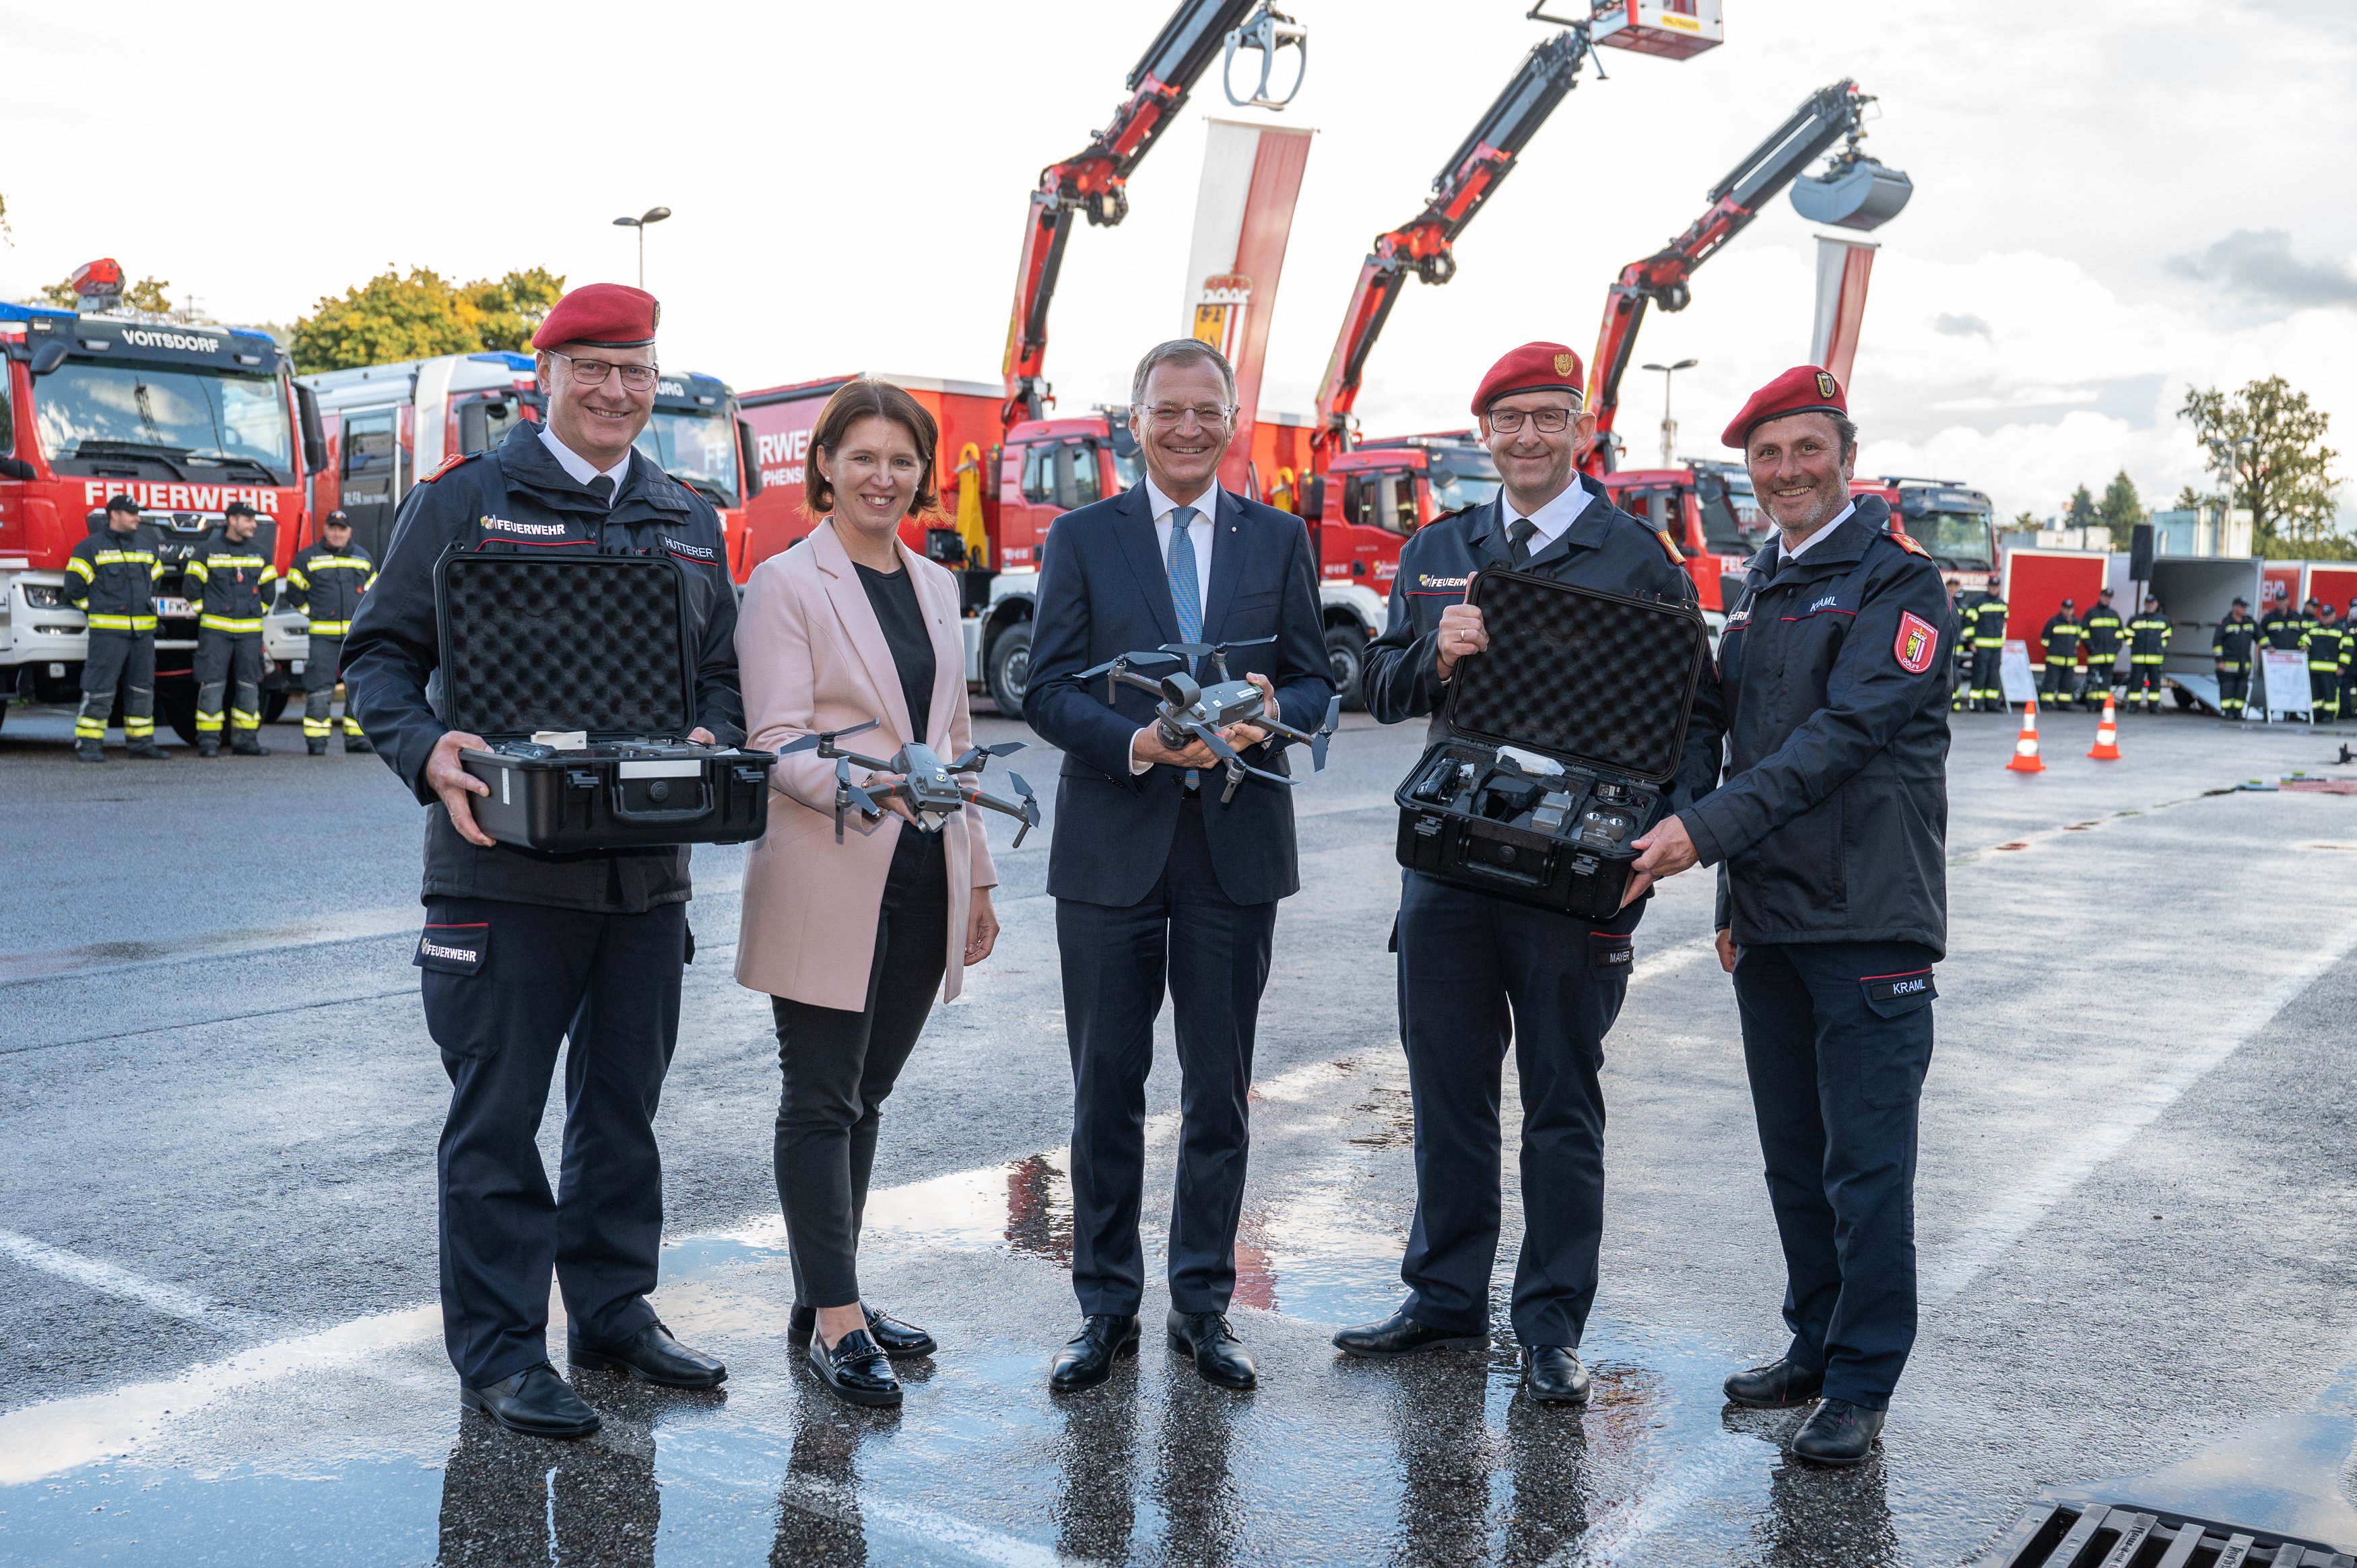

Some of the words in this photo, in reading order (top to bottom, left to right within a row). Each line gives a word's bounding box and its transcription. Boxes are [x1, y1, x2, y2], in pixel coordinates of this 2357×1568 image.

[121, 329, 220, 353] VOITSDORF
[762, 466, 805, 487] PHENS
[85, 481, 279, 513] FEUERWEHR
[497, 519, 566, 535] FEUERWEHR
[665, 537, 715, 558] HUTTERER
[427, 944, 477, 962] FEUERWEHR
[1893, 979, 1926, 994] KRAML
